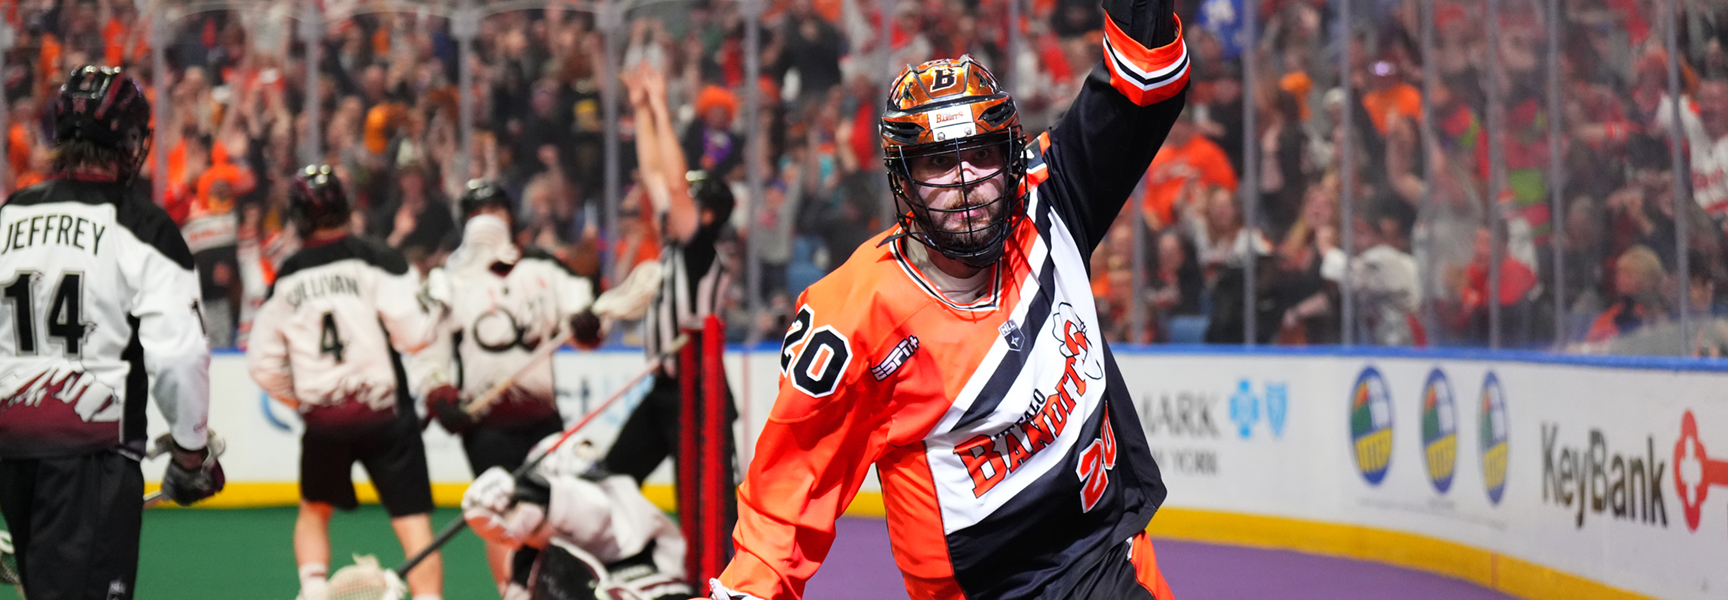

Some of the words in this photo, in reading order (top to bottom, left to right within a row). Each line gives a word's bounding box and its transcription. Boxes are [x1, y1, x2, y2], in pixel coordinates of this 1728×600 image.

[930, 67, 957, 92] B
[1, 214, 106, 256] JEFFREY
[0, 270, 97, 361] 14
[319, 311, 349, 366] 4
[780, 303, 853, 398] 20
[871, 334, 920, 382] ESPN+
[1075, 400, 1117, 514] 20
[1541, 422, 1669, 529] KeyBank
